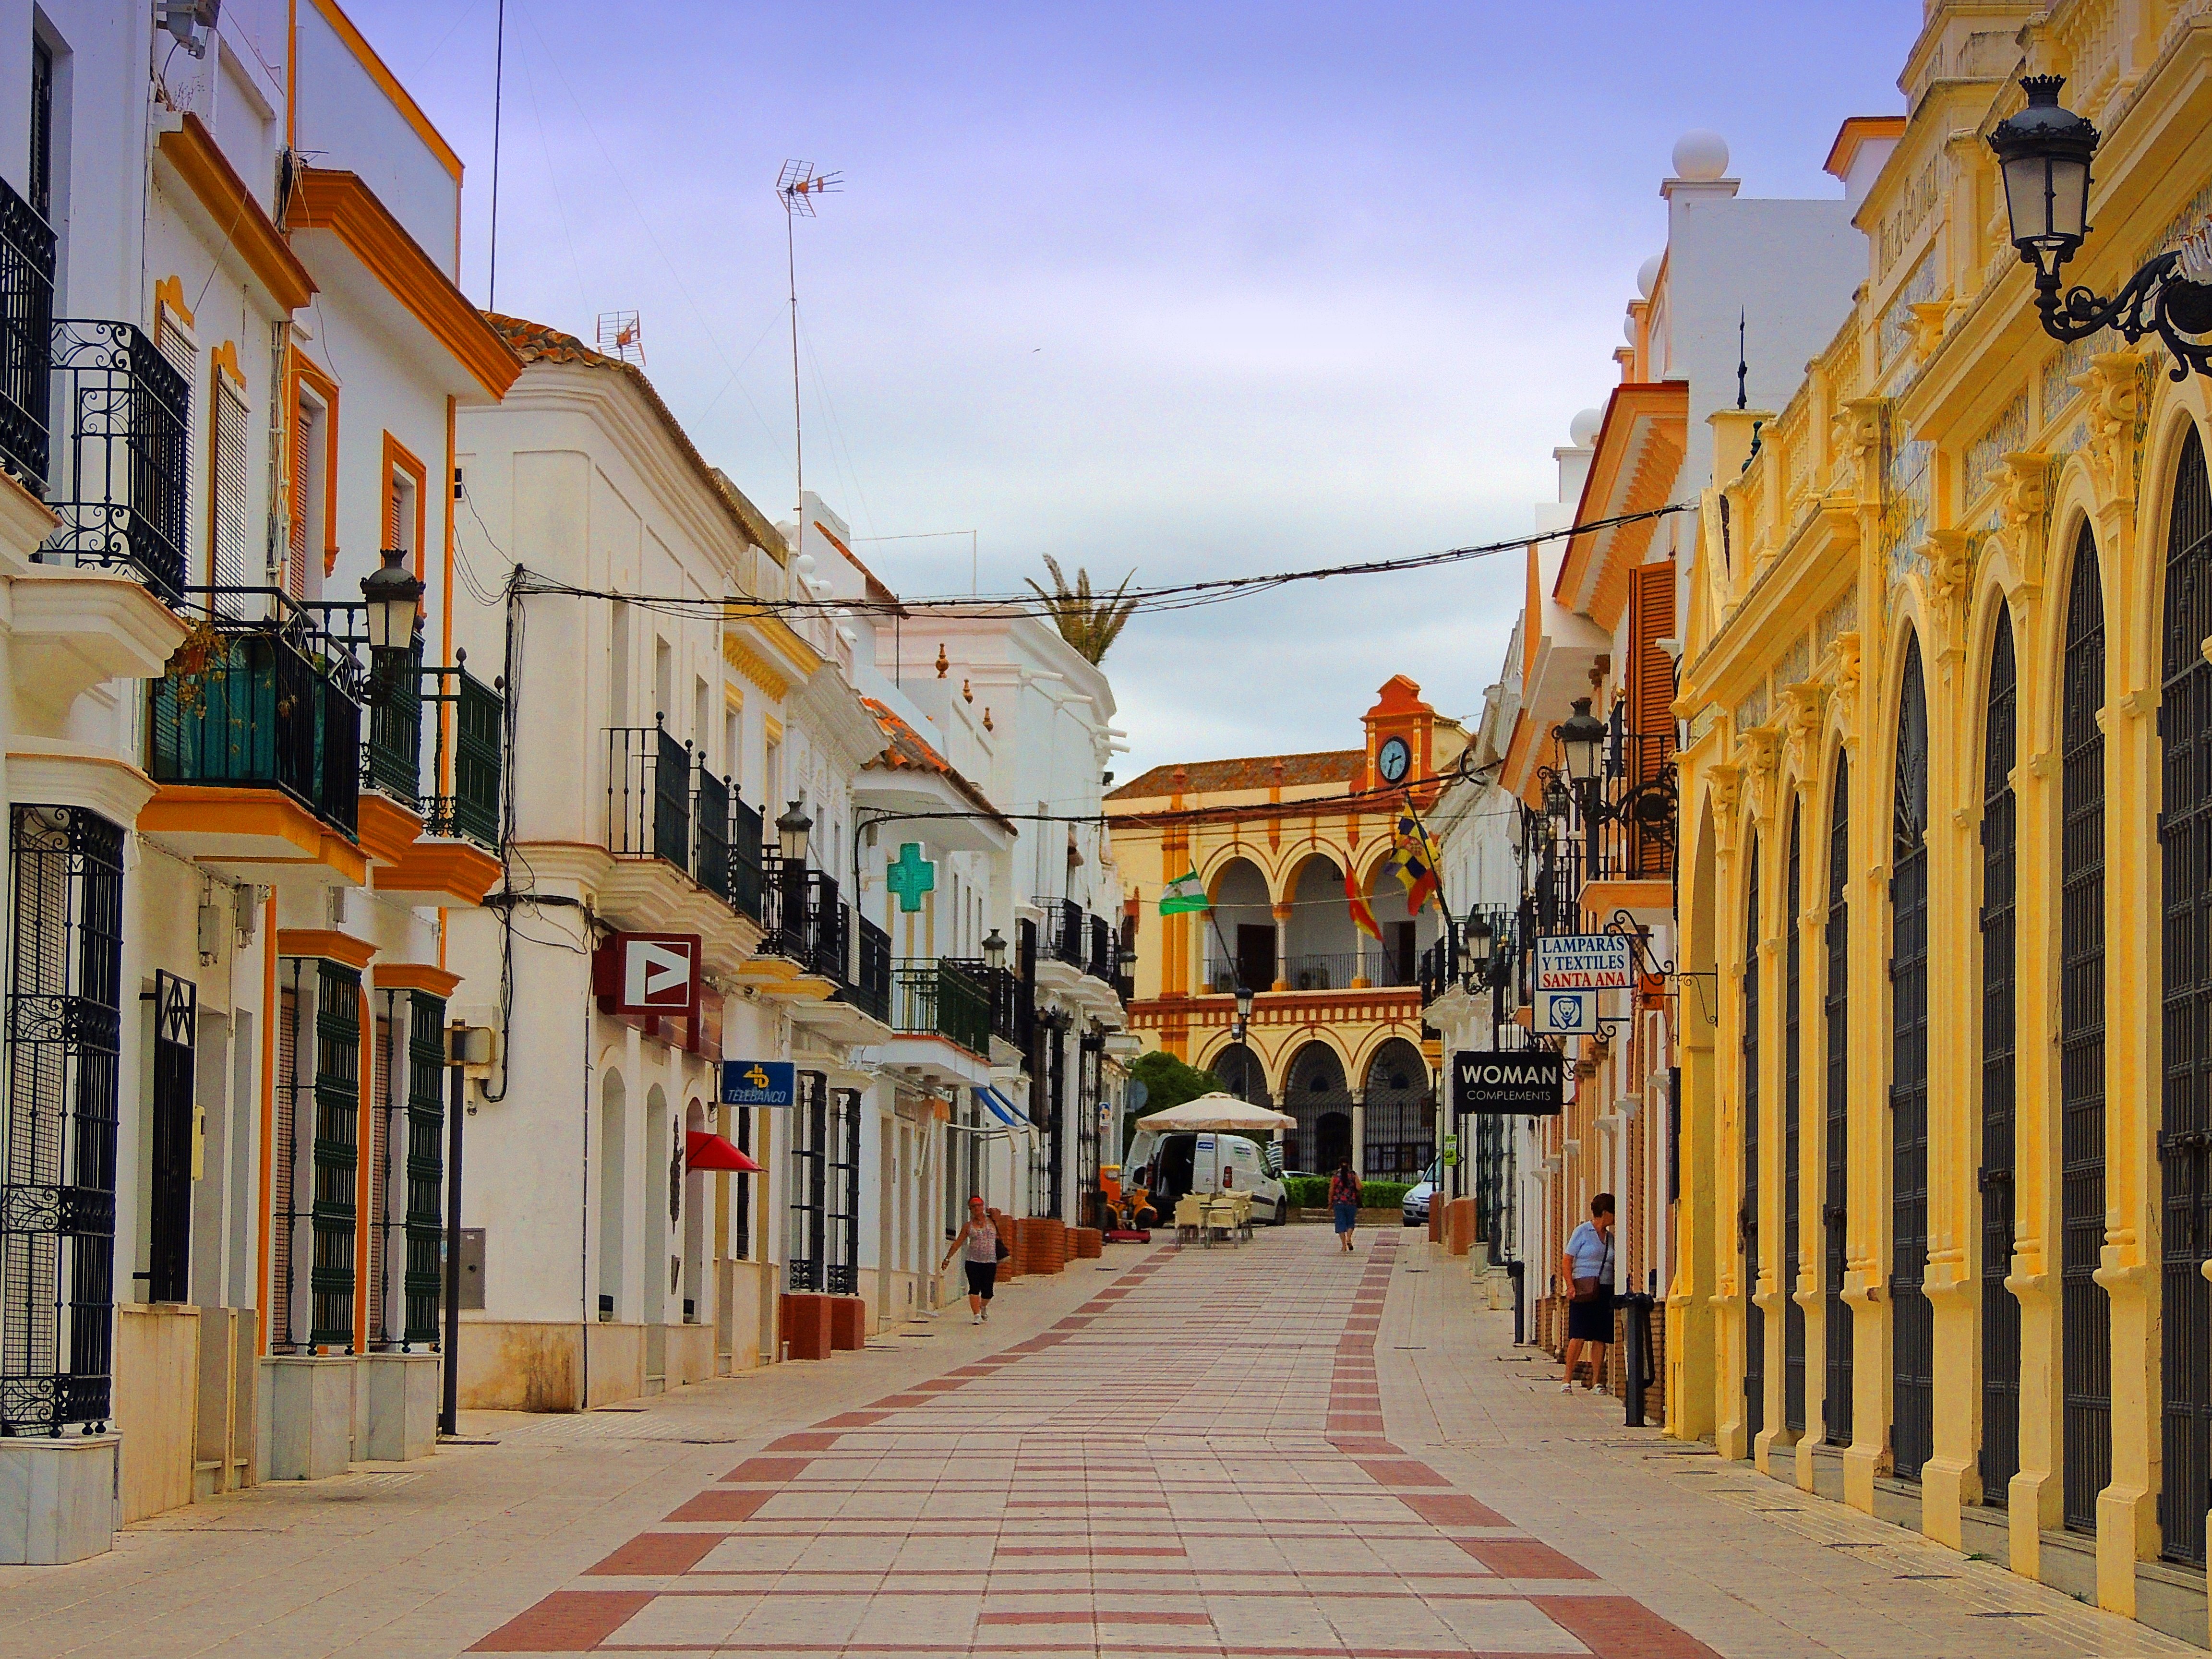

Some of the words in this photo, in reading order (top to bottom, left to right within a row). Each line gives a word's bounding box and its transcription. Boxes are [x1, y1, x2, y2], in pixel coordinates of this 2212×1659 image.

[1542, 937, 1624, 953] LAMPARAS
[1541, 957, 1551, 971] Y
[1554, 954, 1624, 970] TEXTILES
[1543, 972, 1592, 987] SANTA
[1595, 972, 1625, 986] ANA
[1462, 1065, 1556, 1084] WOMAN
[728, 1089, 786, 1103] TELEBANCO
[1467, 1090, 1551, 1101] COMPLEMENTS
